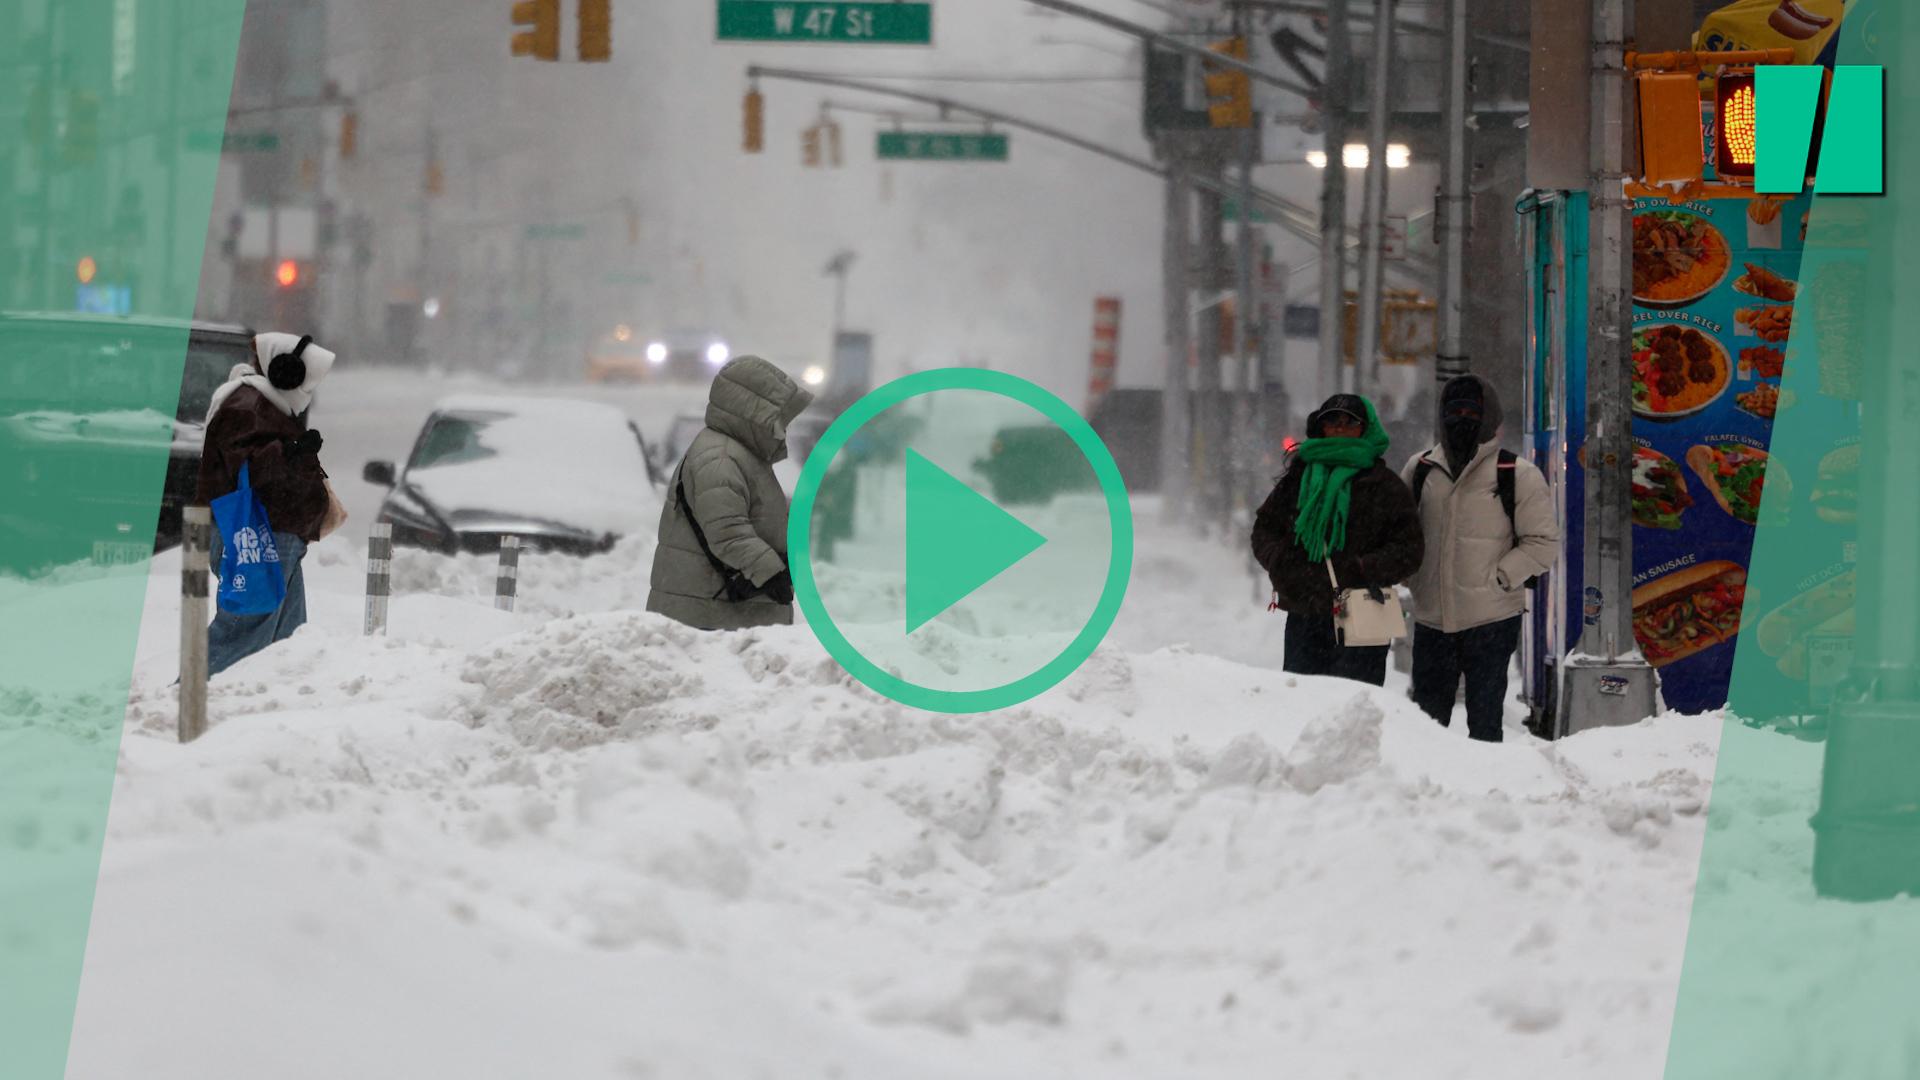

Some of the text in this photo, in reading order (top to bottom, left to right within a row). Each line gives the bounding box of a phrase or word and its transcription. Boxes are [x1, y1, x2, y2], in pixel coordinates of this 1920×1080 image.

[773, 9, 874, 37] W 47 St
[1686, 201, 1714, 216] RICE
[1657, 310, 1689, 321] OVER
[1693, 316, 1720, 332] RICE
[1704, 433, 1764, 448] FALAFEL GYRO
[1648, 554, 1696, 577] SAUSAGE
